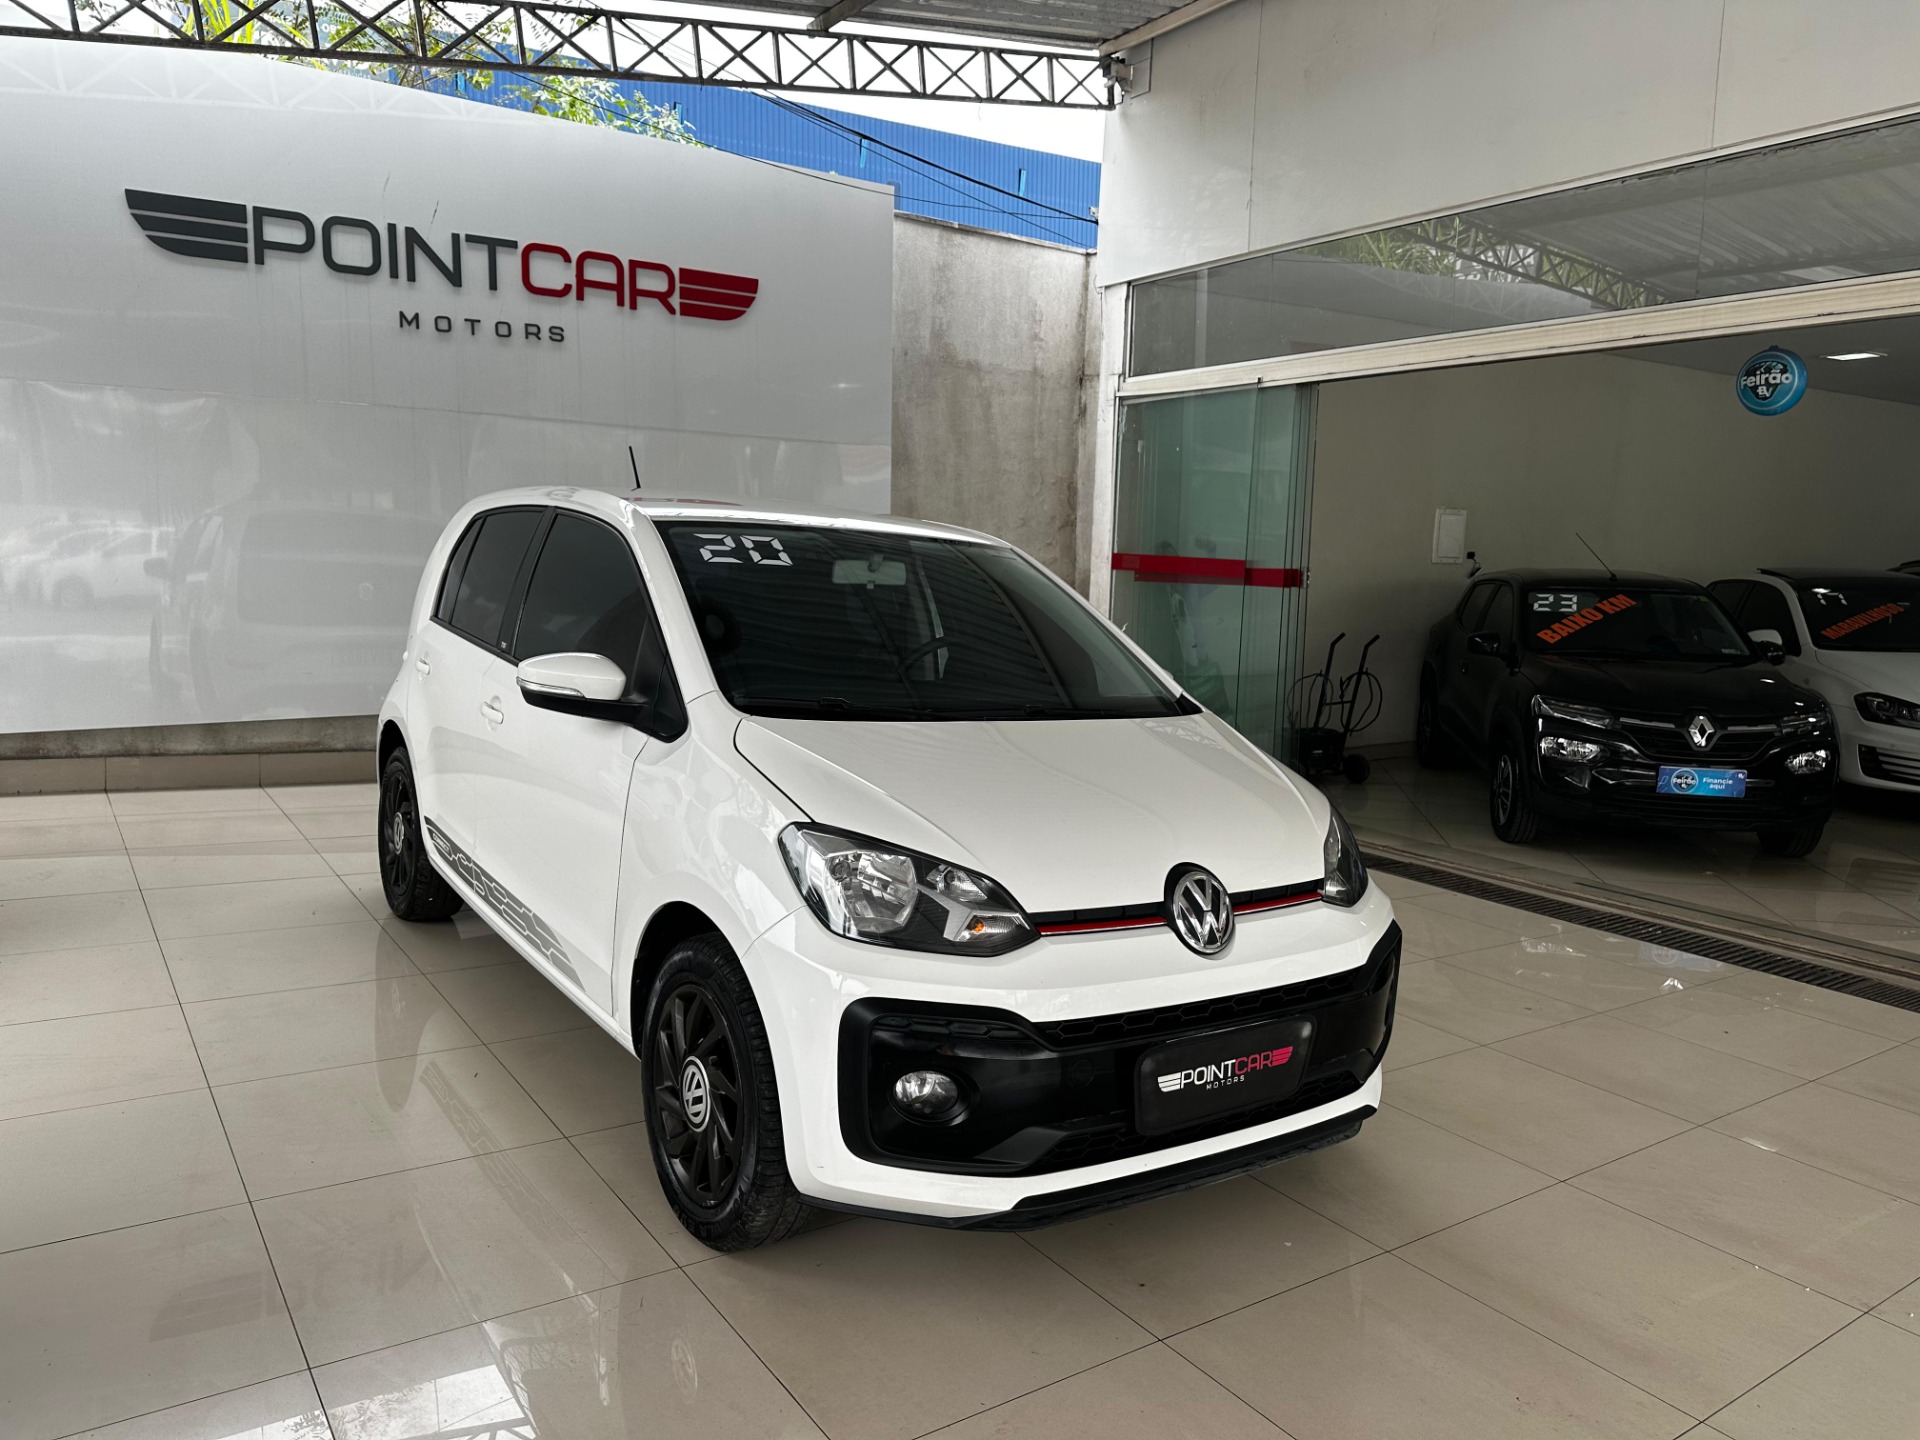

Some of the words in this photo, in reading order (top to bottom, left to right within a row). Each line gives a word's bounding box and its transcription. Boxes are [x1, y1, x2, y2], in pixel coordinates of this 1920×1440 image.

[399, 310, 565, 343] MOTORS
[1740, 369, 1793, 389] Feirão
[693, 533, 794, 566] 20
[1533, 593, 1578, 612] 23
[1536, 607, 1604, 644] BAIXO
[1595, 593, 1638, 615] KM
[1702, 777, 1734, 785] Financie
[1709, 783, 1726, 791] aqui
[1205, 1074, 1246, 1090] MOTORS
